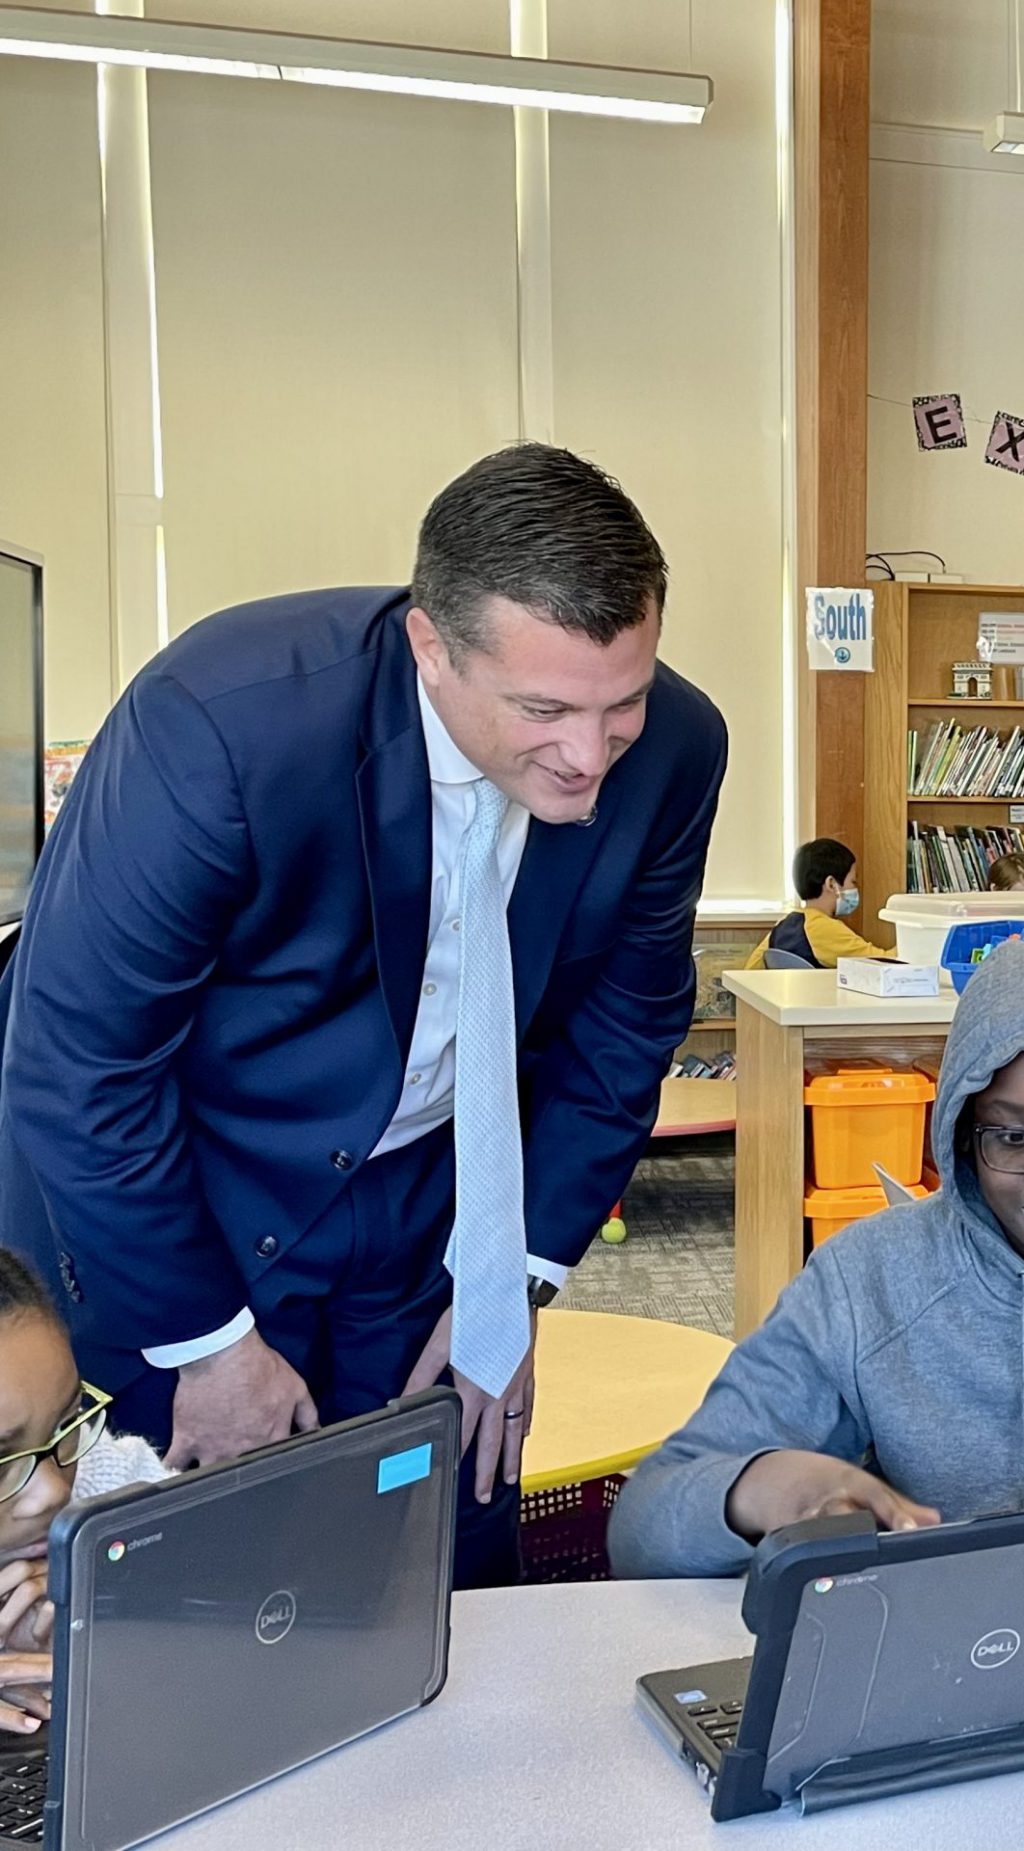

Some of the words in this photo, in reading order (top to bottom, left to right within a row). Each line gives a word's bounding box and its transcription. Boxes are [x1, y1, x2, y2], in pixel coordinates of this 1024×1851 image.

[814, 592, 867, 641] South
[127, 1532, 164, 1551] chrome
[260, 1606, 291, 1629] DELL
[977, 1641, 1014, 1657] DELL
